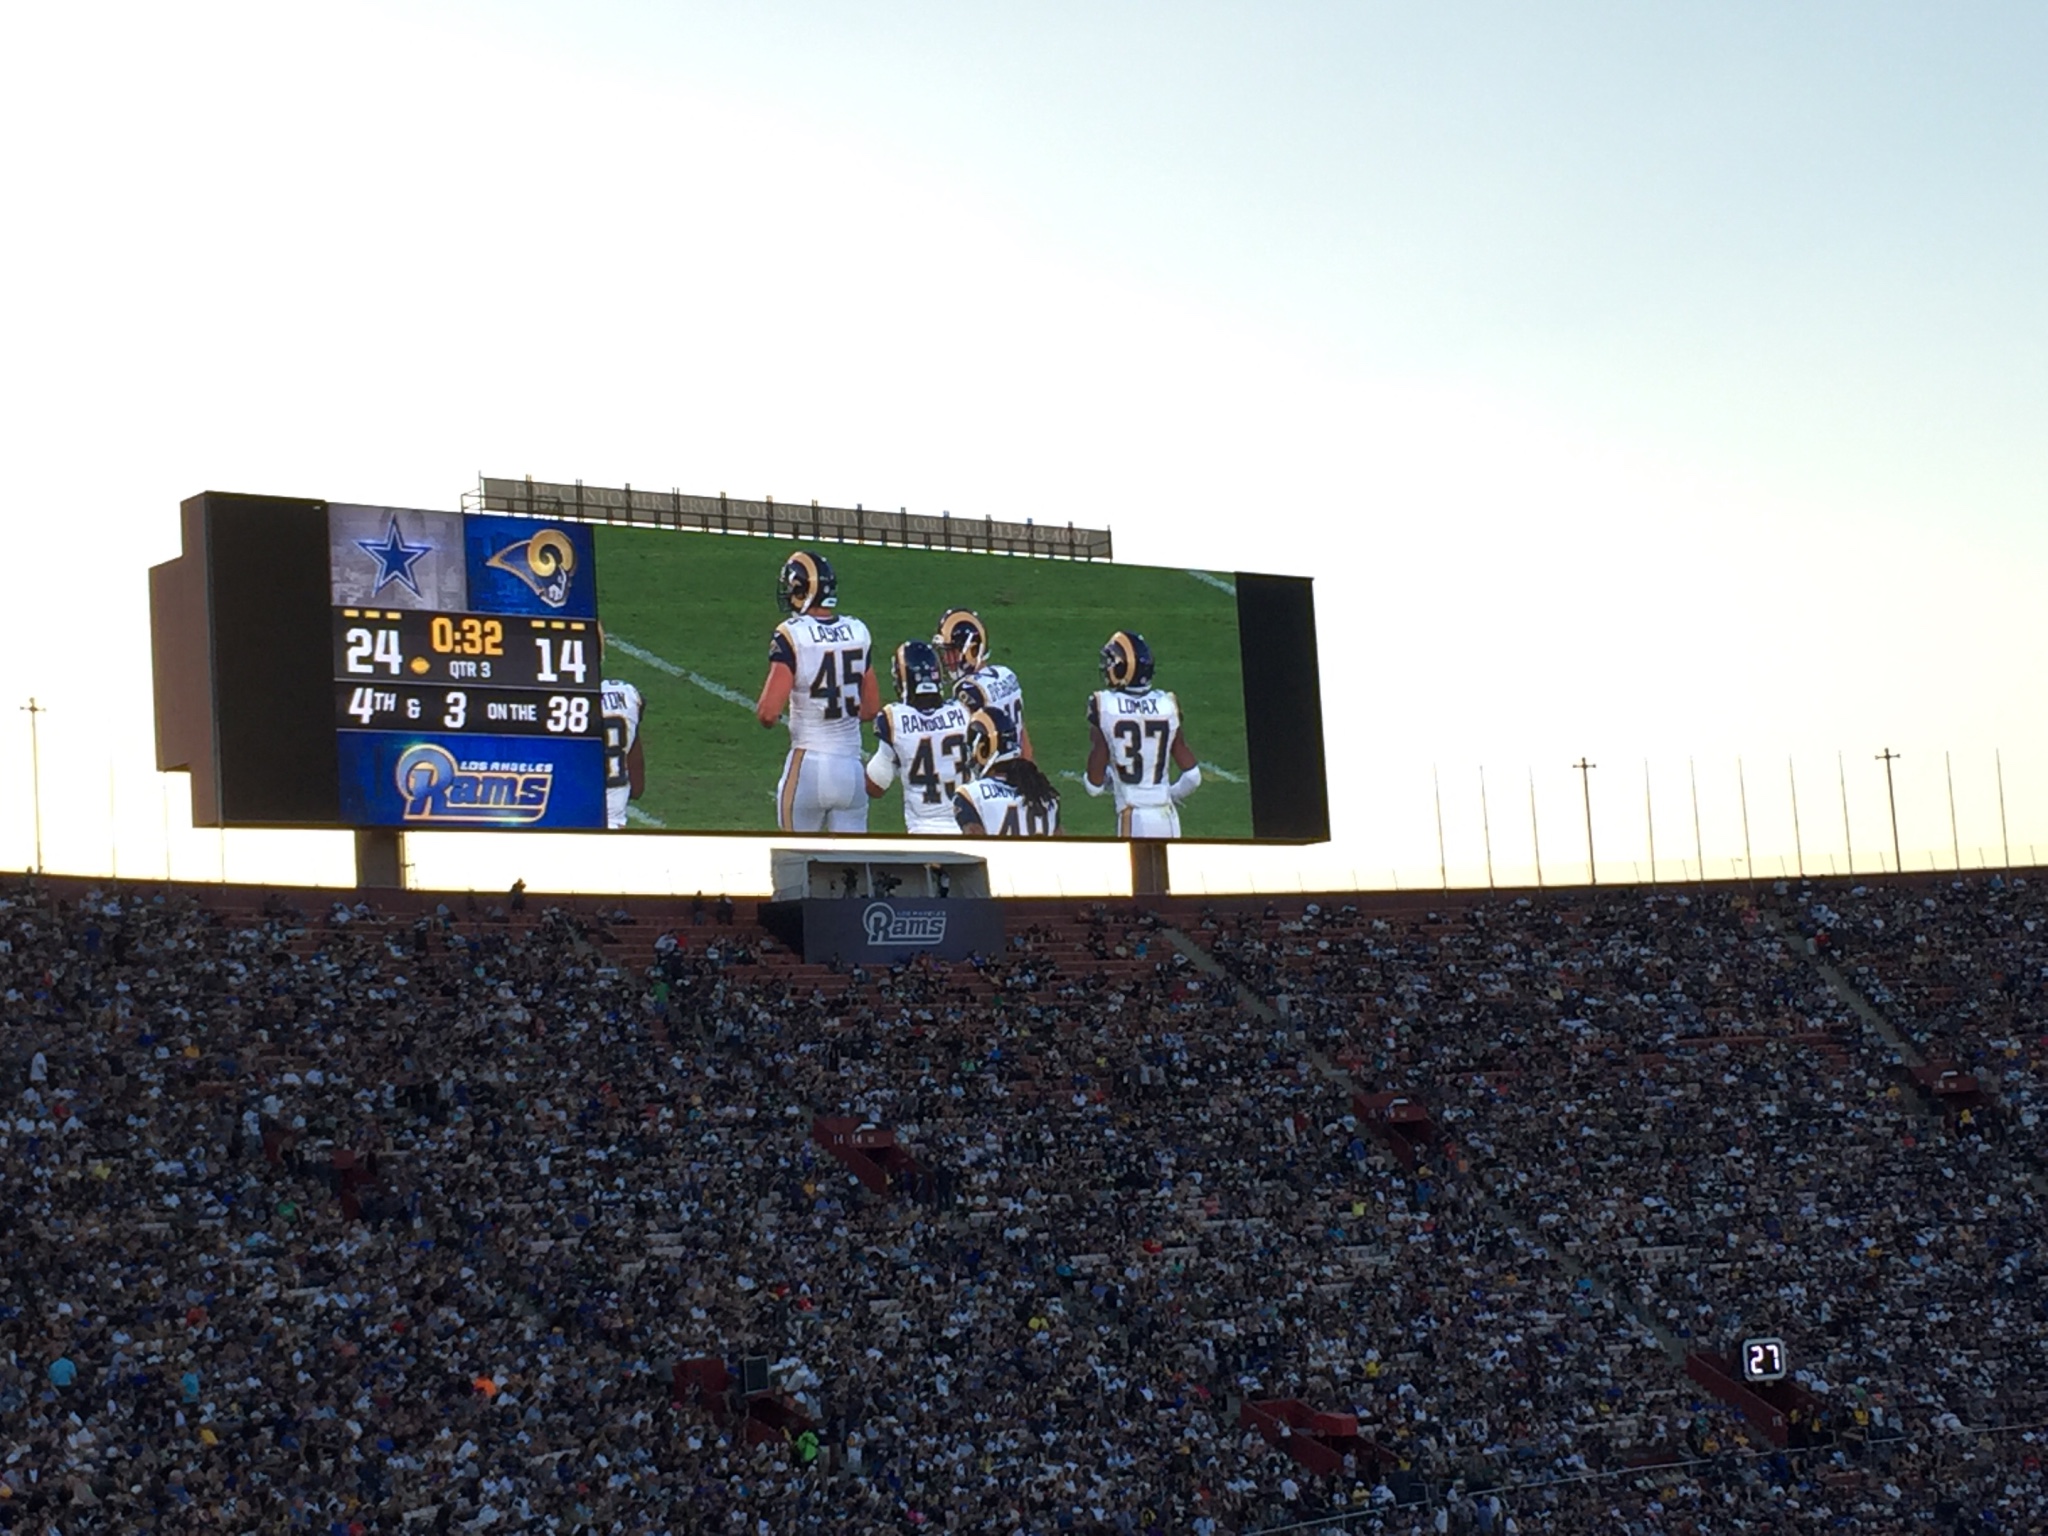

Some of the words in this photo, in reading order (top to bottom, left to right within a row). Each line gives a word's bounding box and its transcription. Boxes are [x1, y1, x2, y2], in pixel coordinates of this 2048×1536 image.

[346, 628, 403, 675] 24
[432, 617, 503, 656] 0:32
[808, 624, 855, 643] LASKEY
[449, 661, 477, 679] QTR
[480, 661, 491, 678] 3
[535, 638, 587, 684] 14
[809, 648, 864, 719] 45
[348, 687, 397, 724] 4TH
[406, 698, 421, 719] &
[443, 691, 467, 728] 3
[487, 702, 508, 720] ON
[509, 704, 538, 721] THE
[547, 696, 590, 733] 38
[901, 708, 966, 734] RANDOLPH
[1117, 698, 1160, 715] LOMAX
[459, 760, 488, 771] LOS
[490, 761, 554, 773] ANGELES
[908, 733, 970, 804] 43
[1113, 719, 1170, 785] 37
[1750, 1344, 1780, 1374] 27
